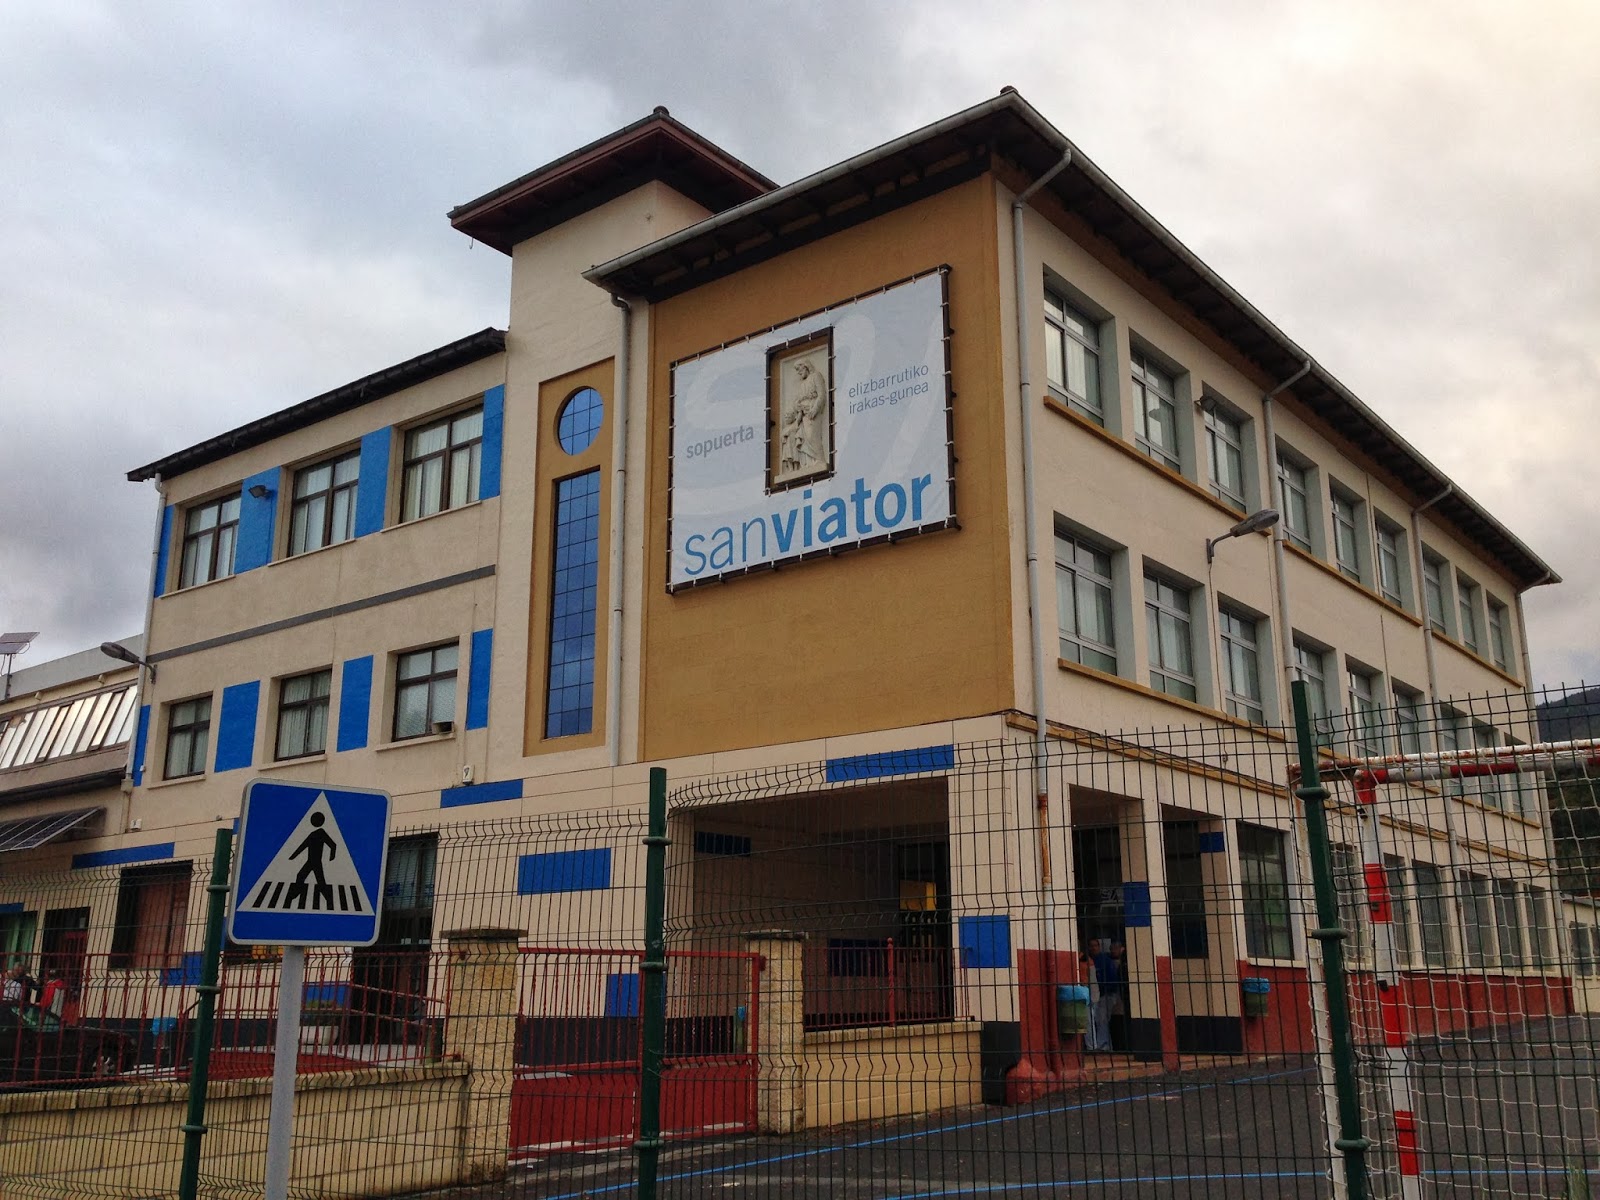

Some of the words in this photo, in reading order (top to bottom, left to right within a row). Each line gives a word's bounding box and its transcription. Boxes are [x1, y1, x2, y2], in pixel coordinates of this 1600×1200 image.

[849, 364, 929, 398] elizbarrutiko
[849, 382, 929, 415] irakas-gunea
[686, 426, 754, 459] sopuerta
[684, 473, 931, 576] sanviator
